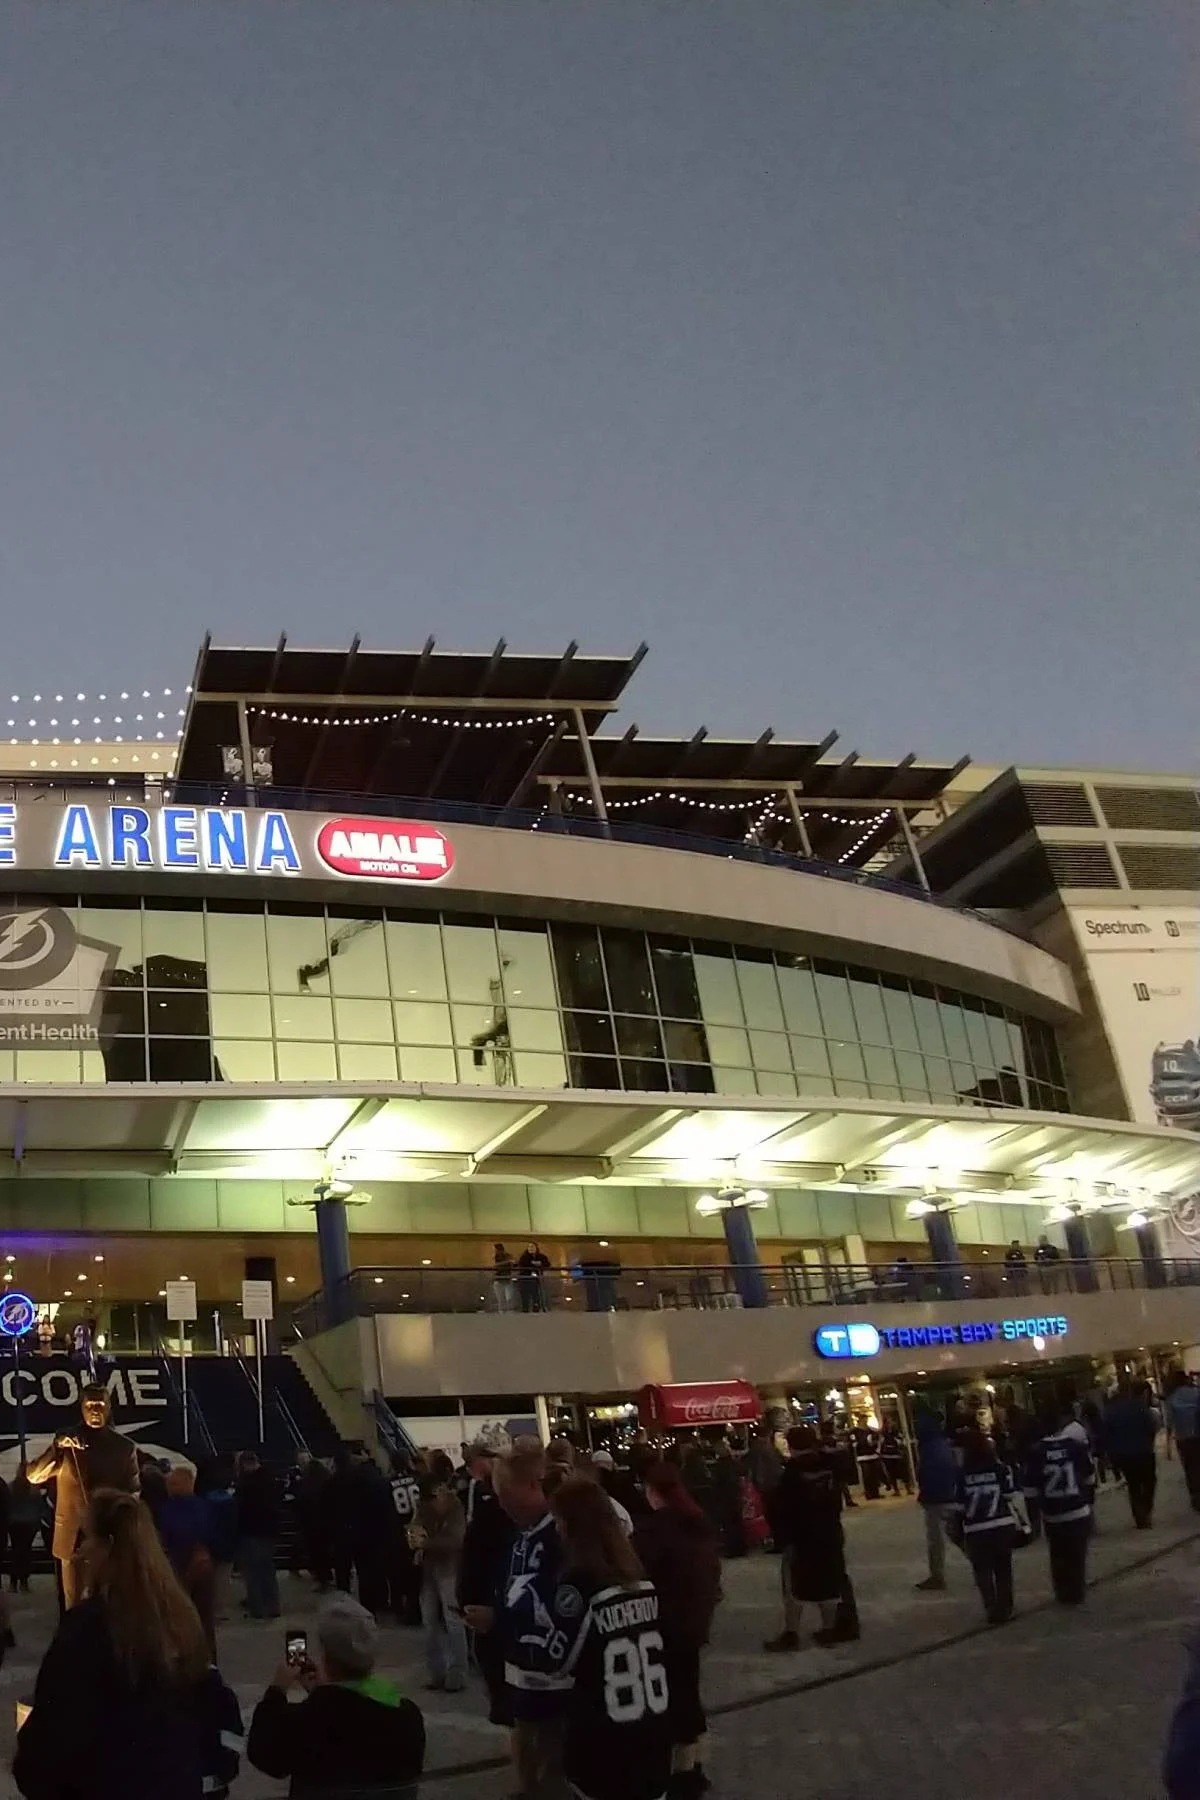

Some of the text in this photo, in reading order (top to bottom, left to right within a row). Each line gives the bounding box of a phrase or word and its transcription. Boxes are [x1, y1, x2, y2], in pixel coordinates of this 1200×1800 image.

[54, 804, 301, 871] ARENA
[329, 830, 447, 868] AMALIE
[360, 860, 420, 874] MOTOR OIL
[1085, 919, 1146, 938] Spectrum
[44, 999, 61, 1008] BY
[1133, 982, 1150, 1001] 10
[1163, 1060, 1178, 1073] 10
[883, 1317, 1068, 1348] TAMPA BAY SPORTS
[1043, 1461, 1080, 1498] 21
[964, 1483, 1001, 1518] 77
[594, 1596, 659, 1635] KUCHEROV
[603, 1629, 670, 1723] 86
